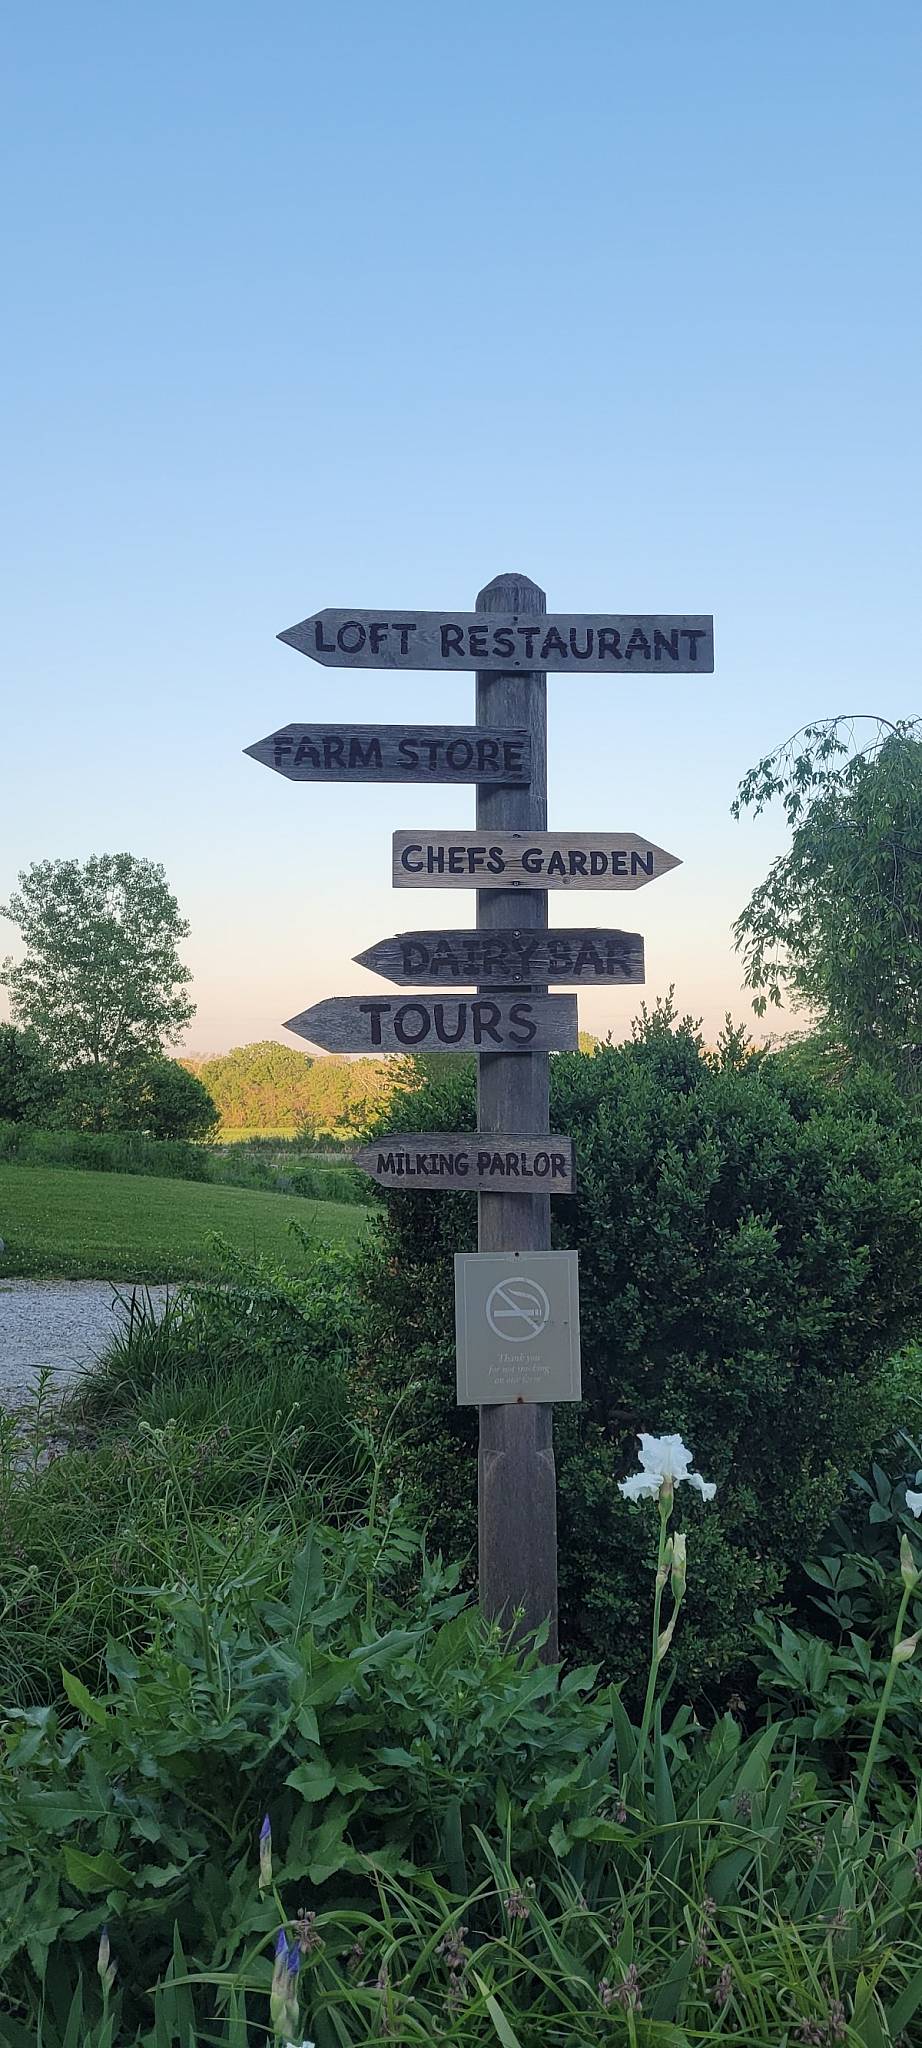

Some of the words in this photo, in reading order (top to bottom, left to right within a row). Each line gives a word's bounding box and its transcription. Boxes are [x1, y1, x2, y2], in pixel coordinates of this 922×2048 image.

[315, 620, 416, 655] LOFT
[440, 624, 706, 660] RESTAURANT
[273, 736, 382, 769] FARM
[397, 738, 525, 772] STORE
[400, 845, 505, 874] CHEFS
[521, 848, 654, 875] GARDEN
[402, 939, 539, 975] DAIRY
[547, 939, 633, 976] BAR
[359, 1003, 537, 1045] TOURS
[376, 1153, 468, 1176] MILKING
[477, 1152, 568, 1178] PARLOR
